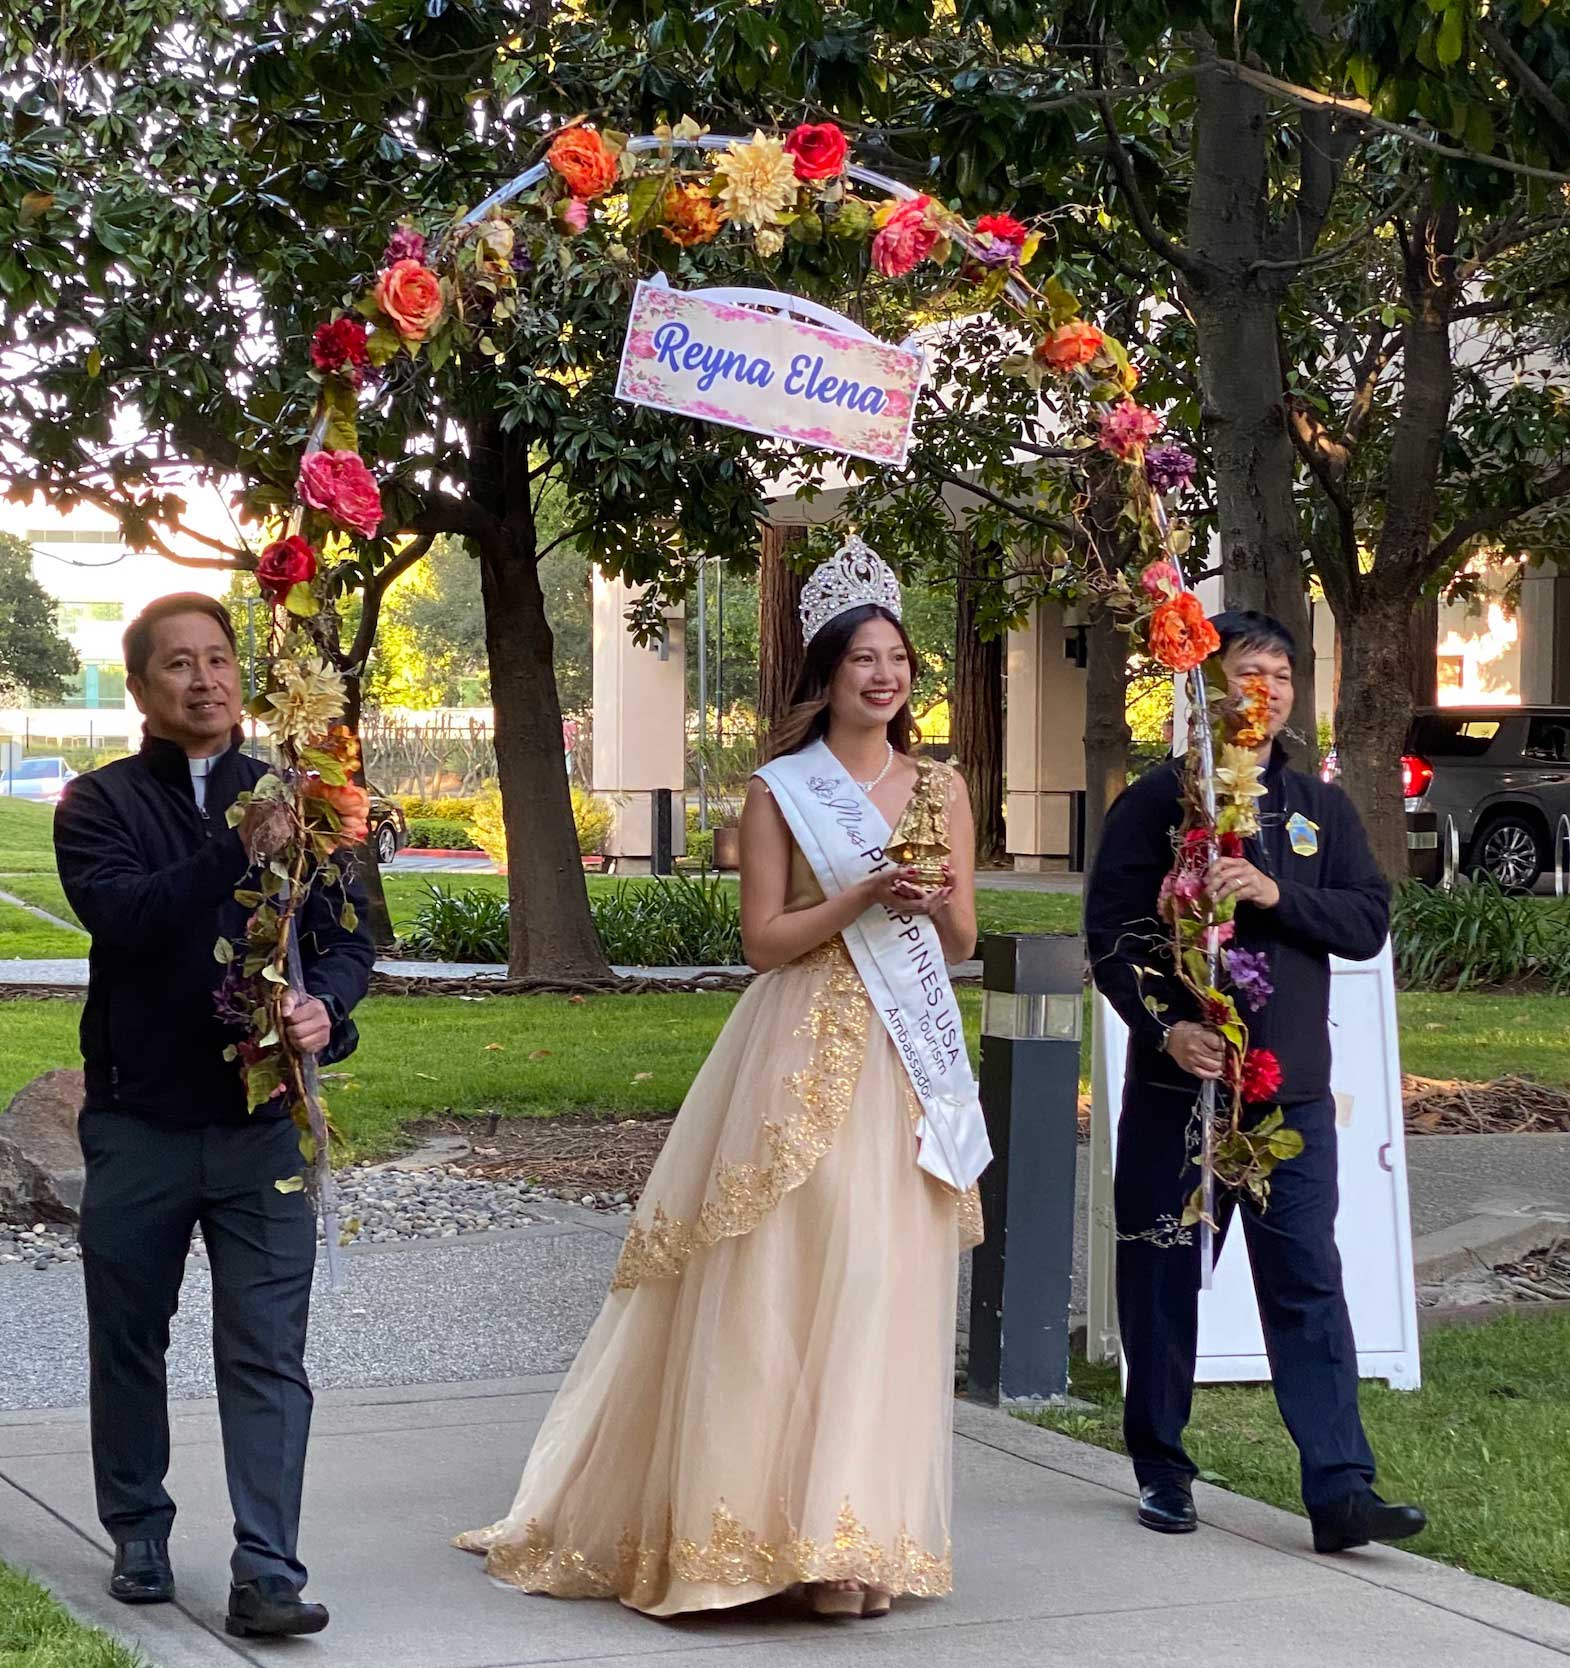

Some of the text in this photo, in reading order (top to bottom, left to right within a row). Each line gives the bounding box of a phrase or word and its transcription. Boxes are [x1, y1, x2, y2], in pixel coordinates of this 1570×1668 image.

[654, 321, 887, 415] Reyna Elena
[819, 798, 959, 1066] Miss PPPINES USA
[885, 1007, 933, 1100] Ambassador
[918, 1010, 947, 1076] Tourism
